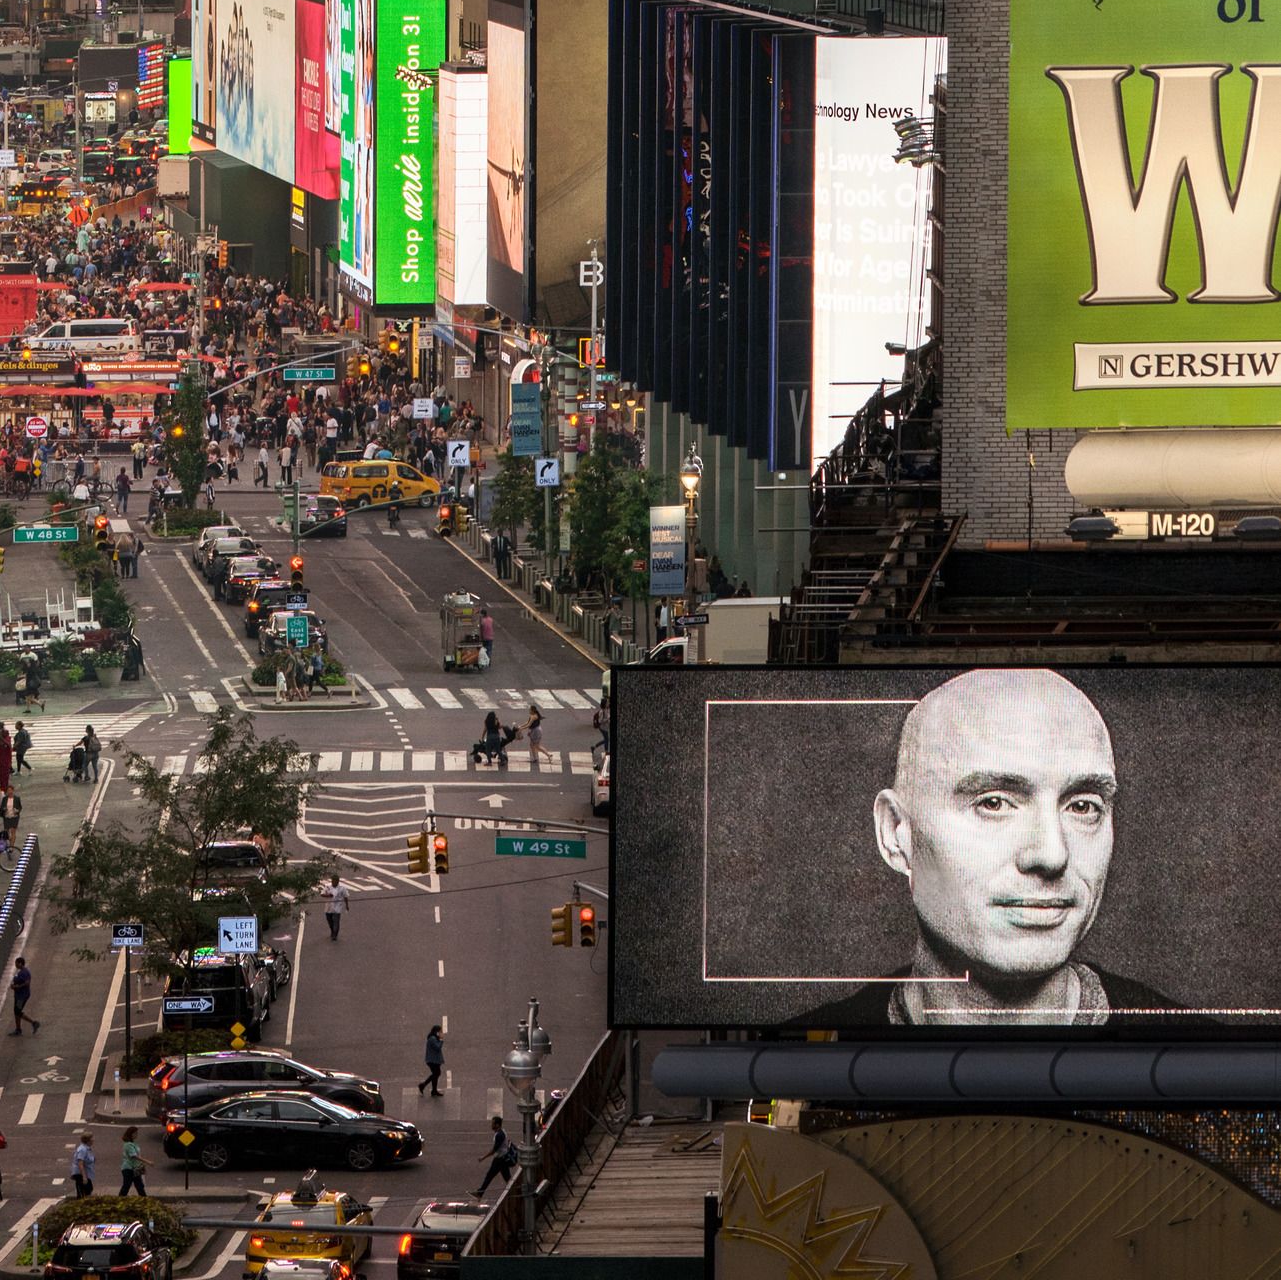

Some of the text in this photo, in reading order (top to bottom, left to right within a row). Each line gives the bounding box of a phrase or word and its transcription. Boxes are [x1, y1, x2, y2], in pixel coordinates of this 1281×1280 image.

[402, 14, 421, 36] 3!
[865, 103, 914, 119] News
[394, 153, 424, 222] aerie
[401, 228, 424, 284] Shop
[295, 370, 325, 380] W 47 St
[450, 457, 467, 465] ONLY
[1150, 513, 1215, 538] M-120
[25, 530, 68, 539] W 48 St
[512, 840, 571, 855] W 49 St
[235, 921, 253, 930] LEFT
[235, 930, 254, 939] TURN
[235, 940, 254, 949] LANE
[167, 1001, 207, 1009] ONE WAY
